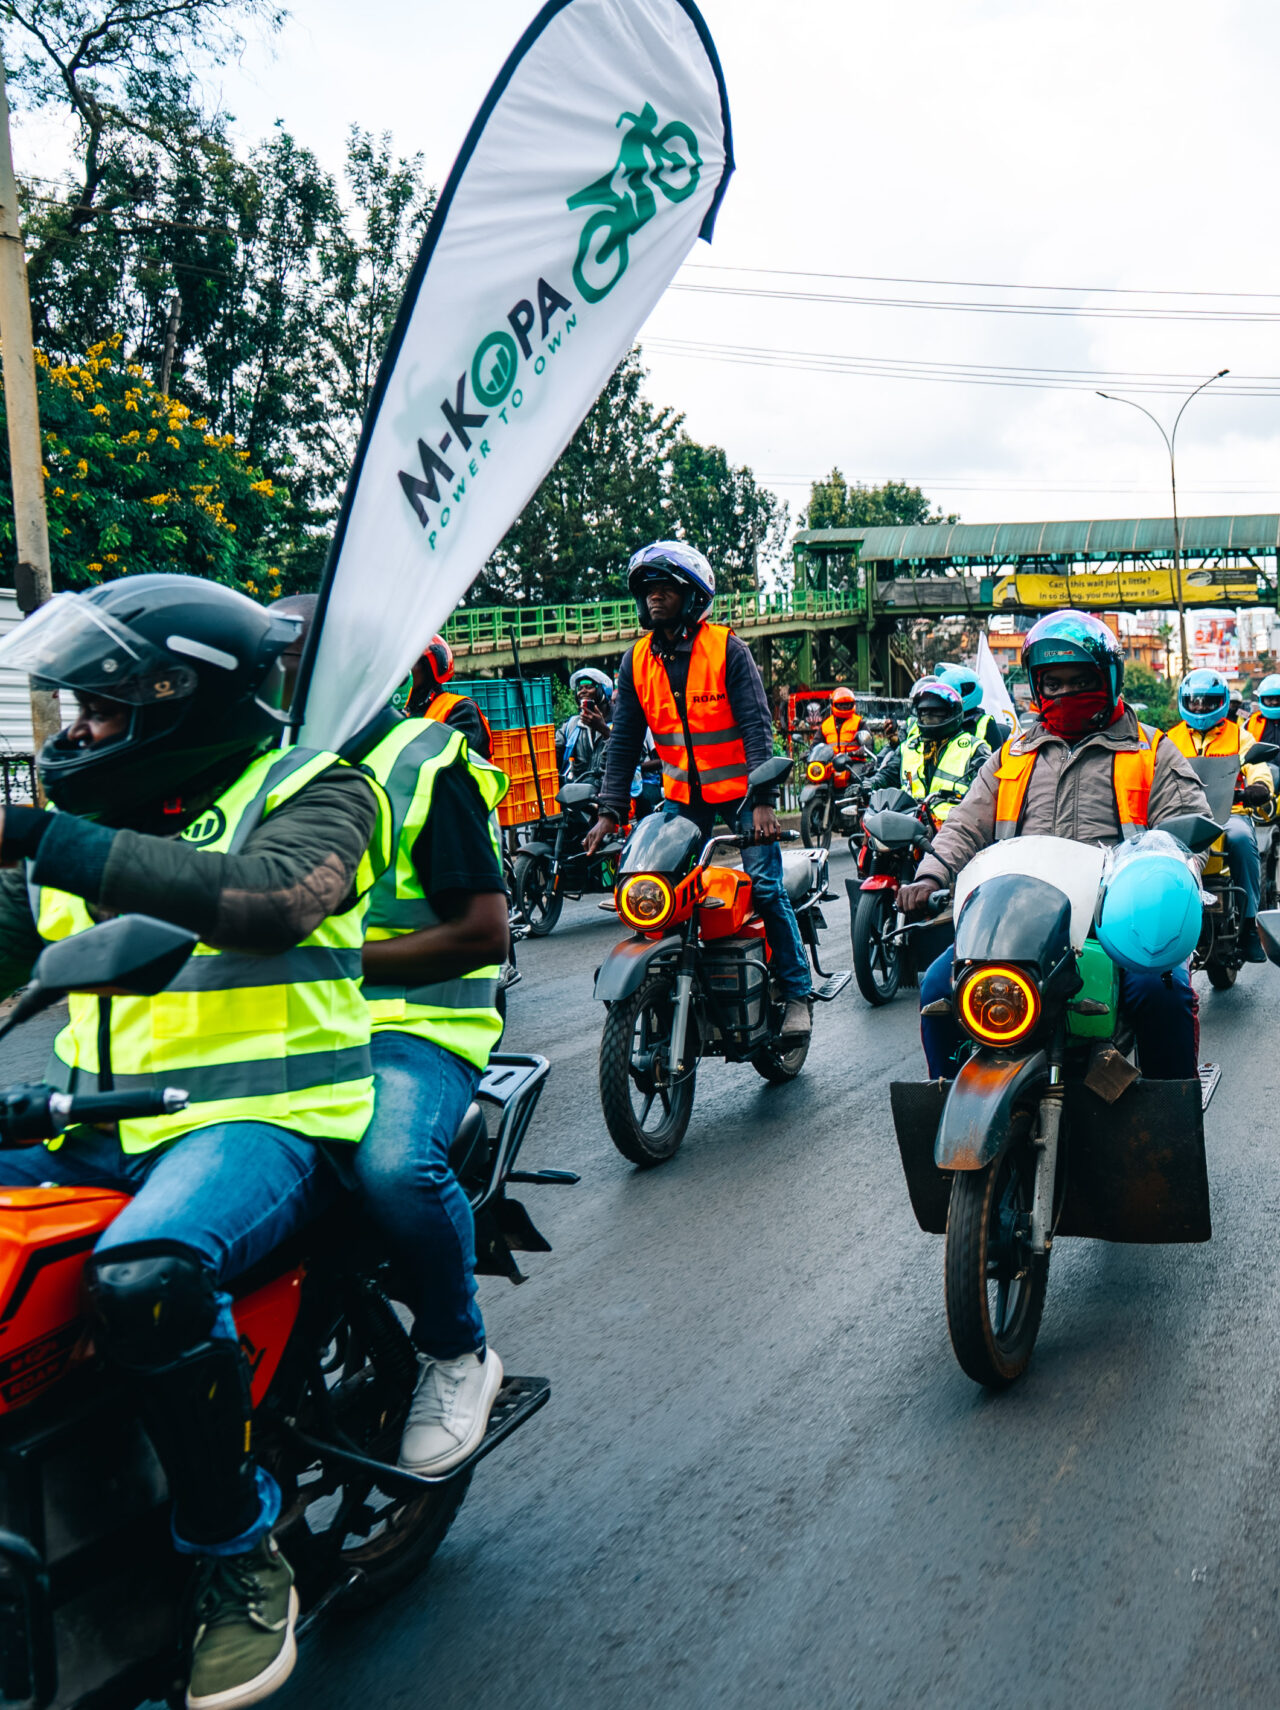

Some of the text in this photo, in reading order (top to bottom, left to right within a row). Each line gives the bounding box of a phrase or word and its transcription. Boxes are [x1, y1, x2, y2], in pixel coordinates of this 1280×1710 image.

[398, 277, 572, 528] M-KOPA
[429, 313, 578, 550] POWER TO OWN
[692, 693, 726, 704] ROAM
